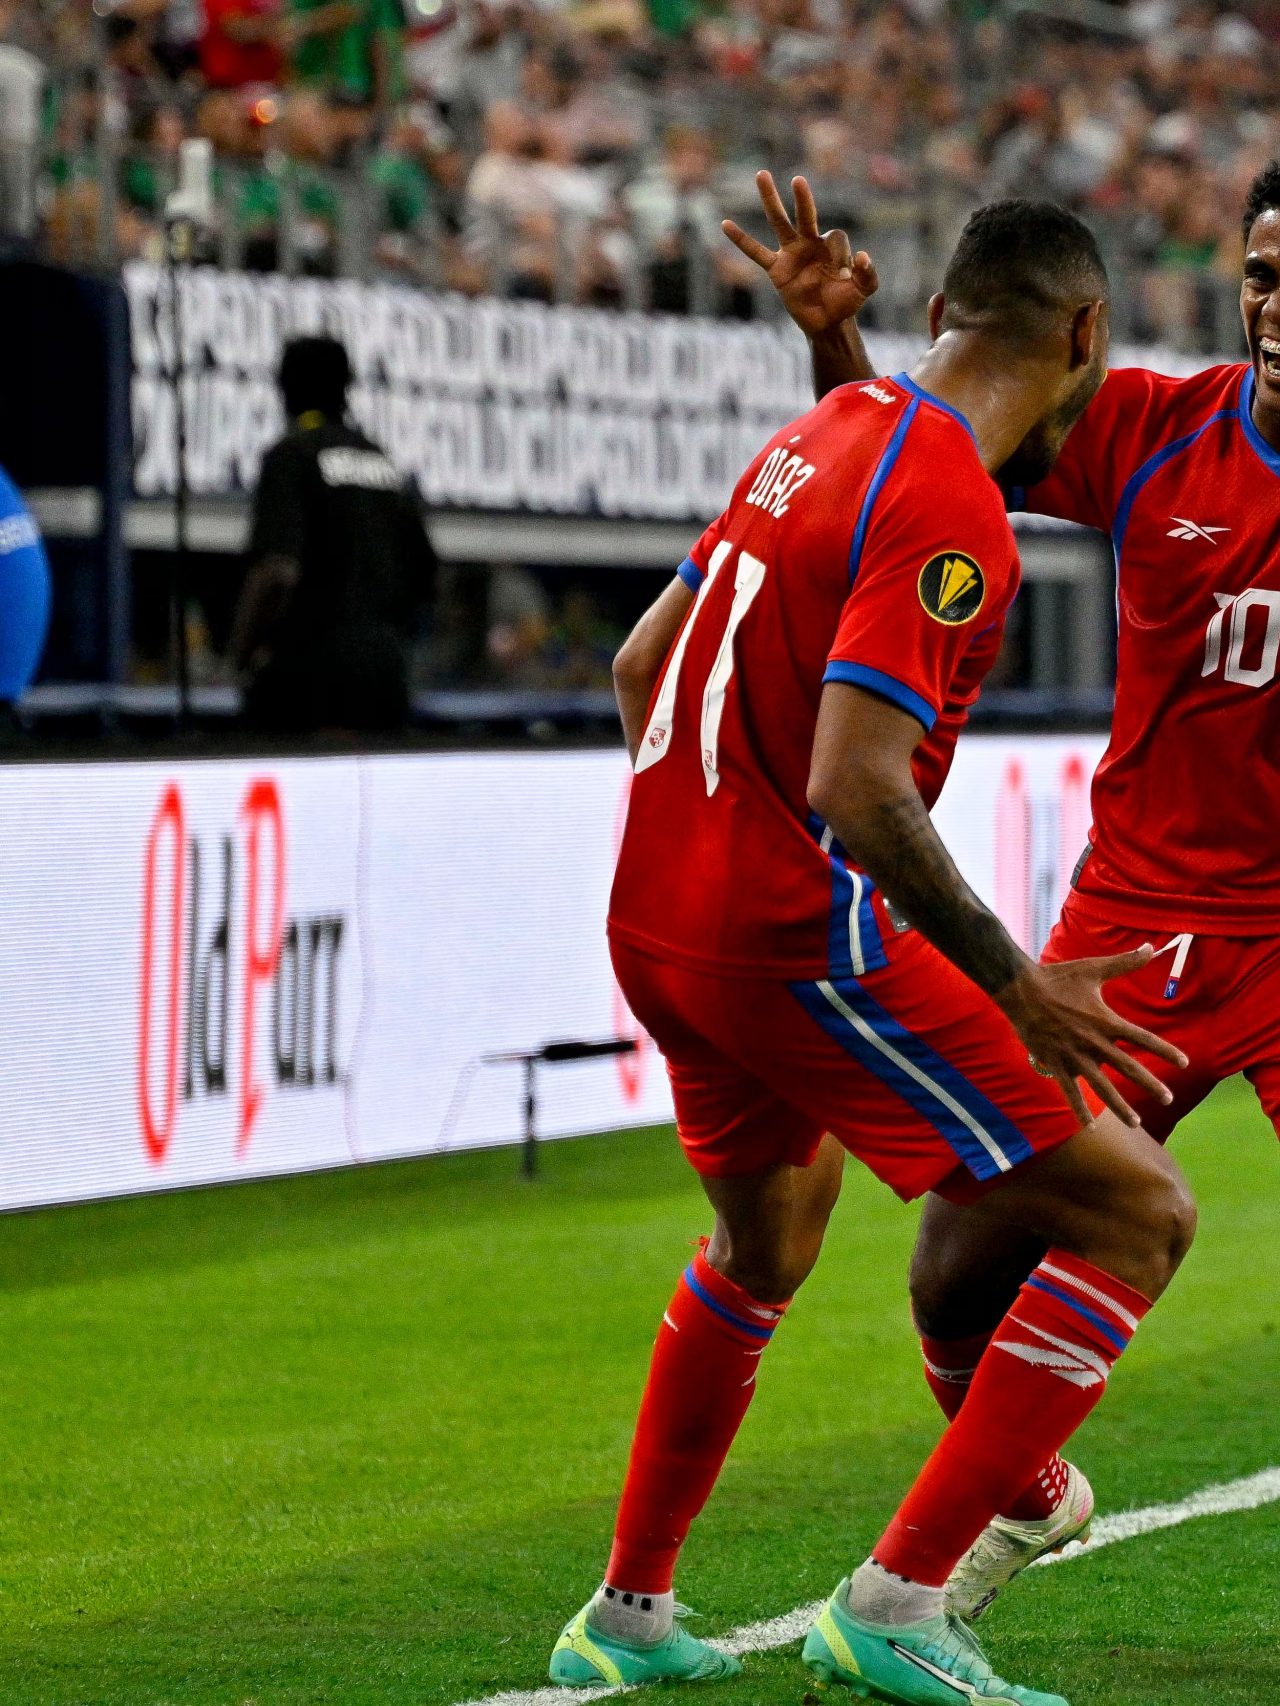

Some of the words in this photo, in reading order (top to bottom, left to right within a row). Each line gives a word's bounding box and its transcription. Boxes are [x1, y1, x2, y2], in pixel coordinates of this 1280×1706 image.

[745, 435, 816, 519] DÍAZ
[634, 540, 766, 797] 11
[137, 778, 235, 1168] Old
[235, 773, 346, 1160] Parr
